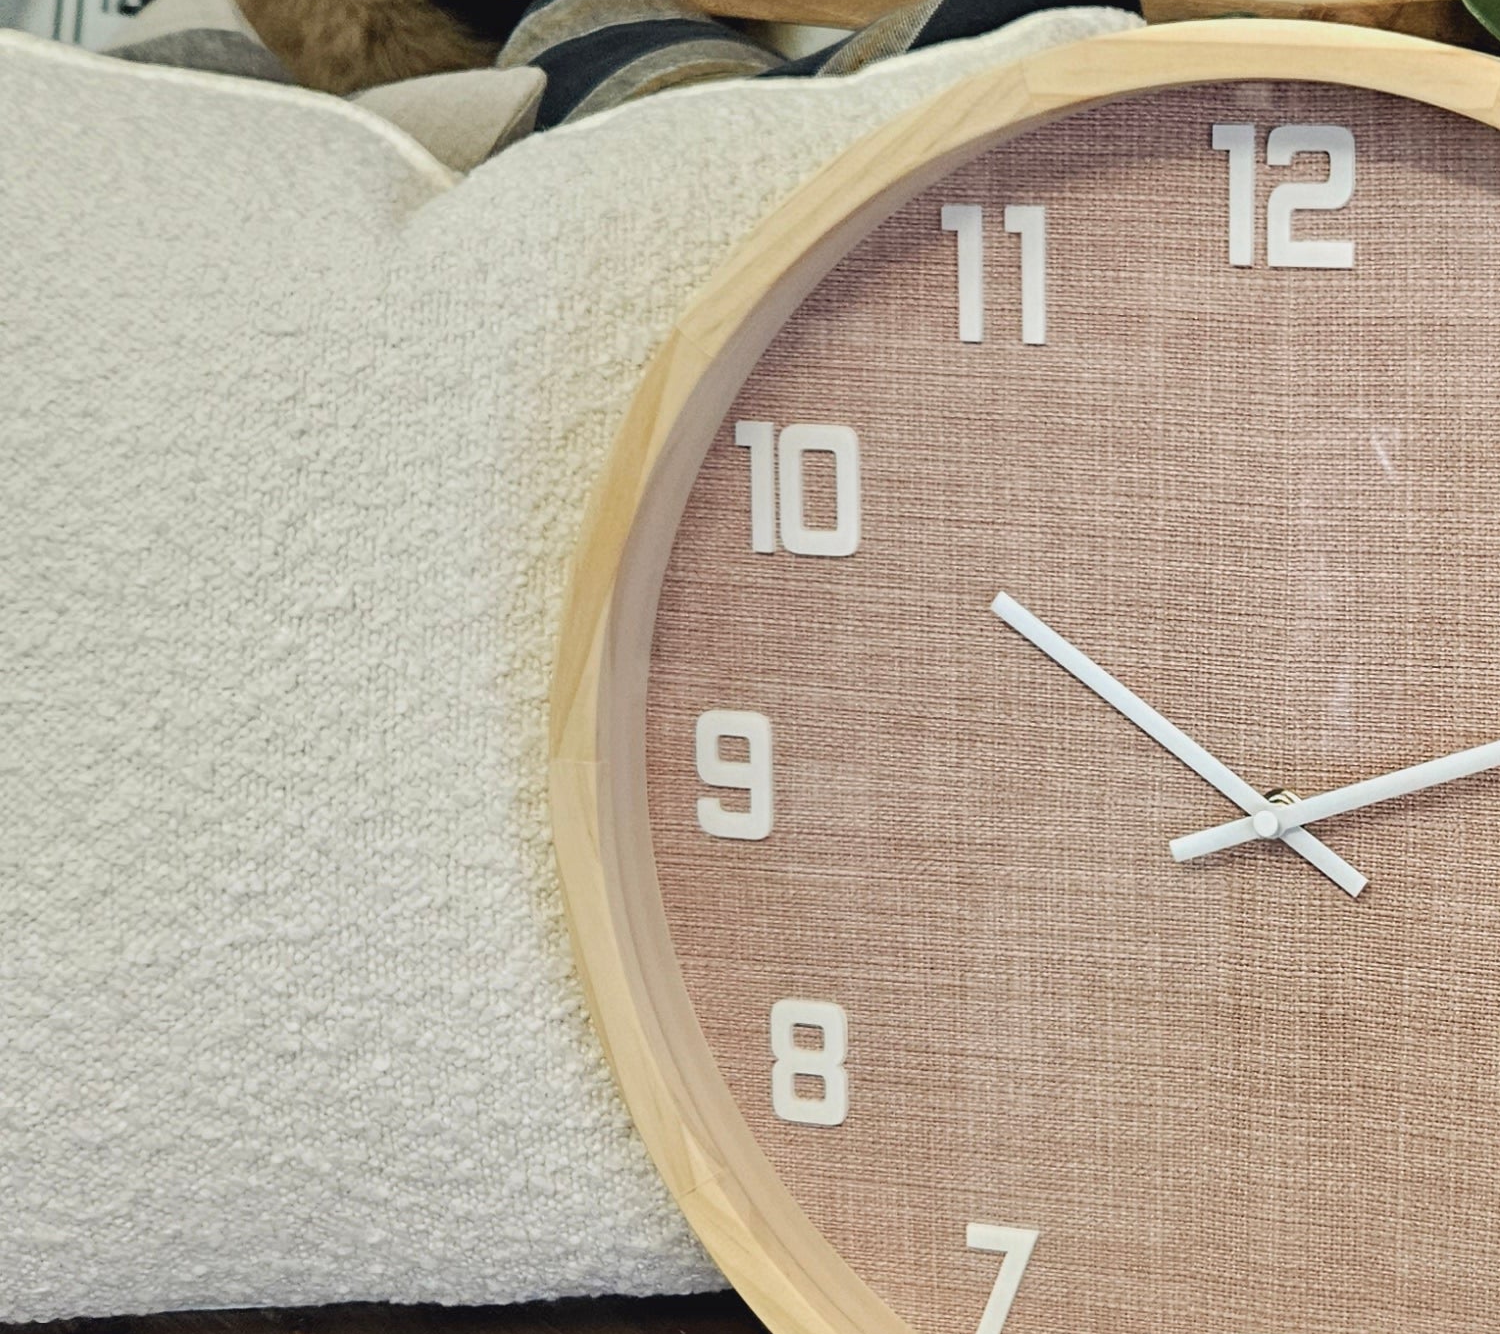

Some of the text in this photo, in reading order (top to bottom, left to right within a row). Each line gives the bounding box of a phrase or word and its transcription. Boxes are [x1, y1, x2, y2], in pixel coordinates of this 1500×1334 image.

[1212, 124, 1357, 269] 12
[941, 204, 1048, 345] 11
[735, 420, 862, 558] 10
[695, 709, 774, 841] 9
[770, 998, 850, 1127] 8
